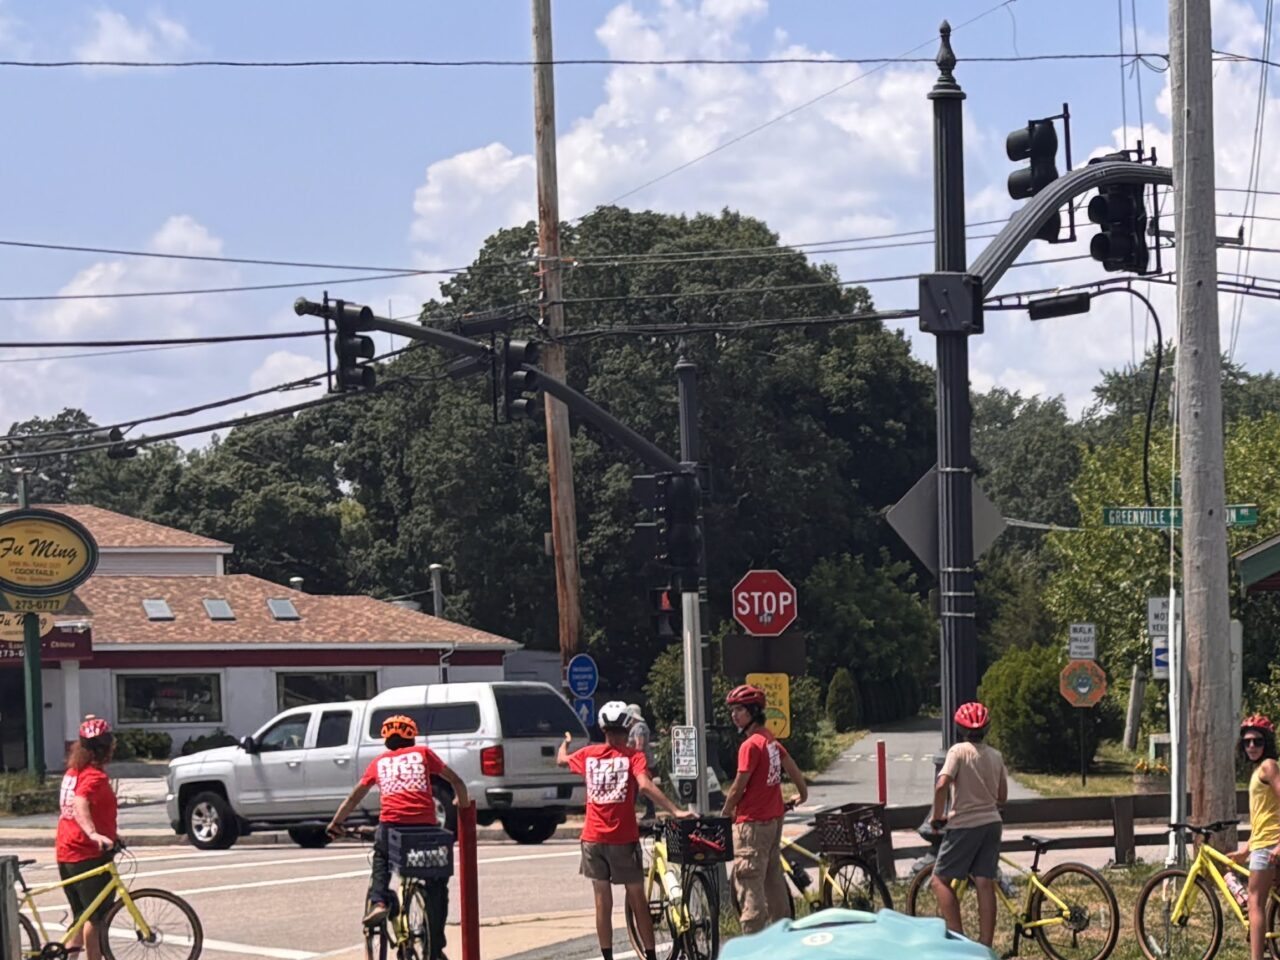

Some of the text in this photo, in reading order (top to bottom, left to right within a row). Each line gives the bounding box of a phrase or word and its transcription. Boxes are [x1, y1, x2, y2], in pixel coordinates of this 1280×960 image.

[1109, 510, 1165, 524] GREENVILLE
[0, 537, 78, 565] Fu Ming
[15, 600, 60, 610] 273-6777
[737, 591, 793, 616] STOP
[1072, 626, 1093, 634] WALK
[377, 752, 424, 769] RED
[586, 757, 630, 772] RED
